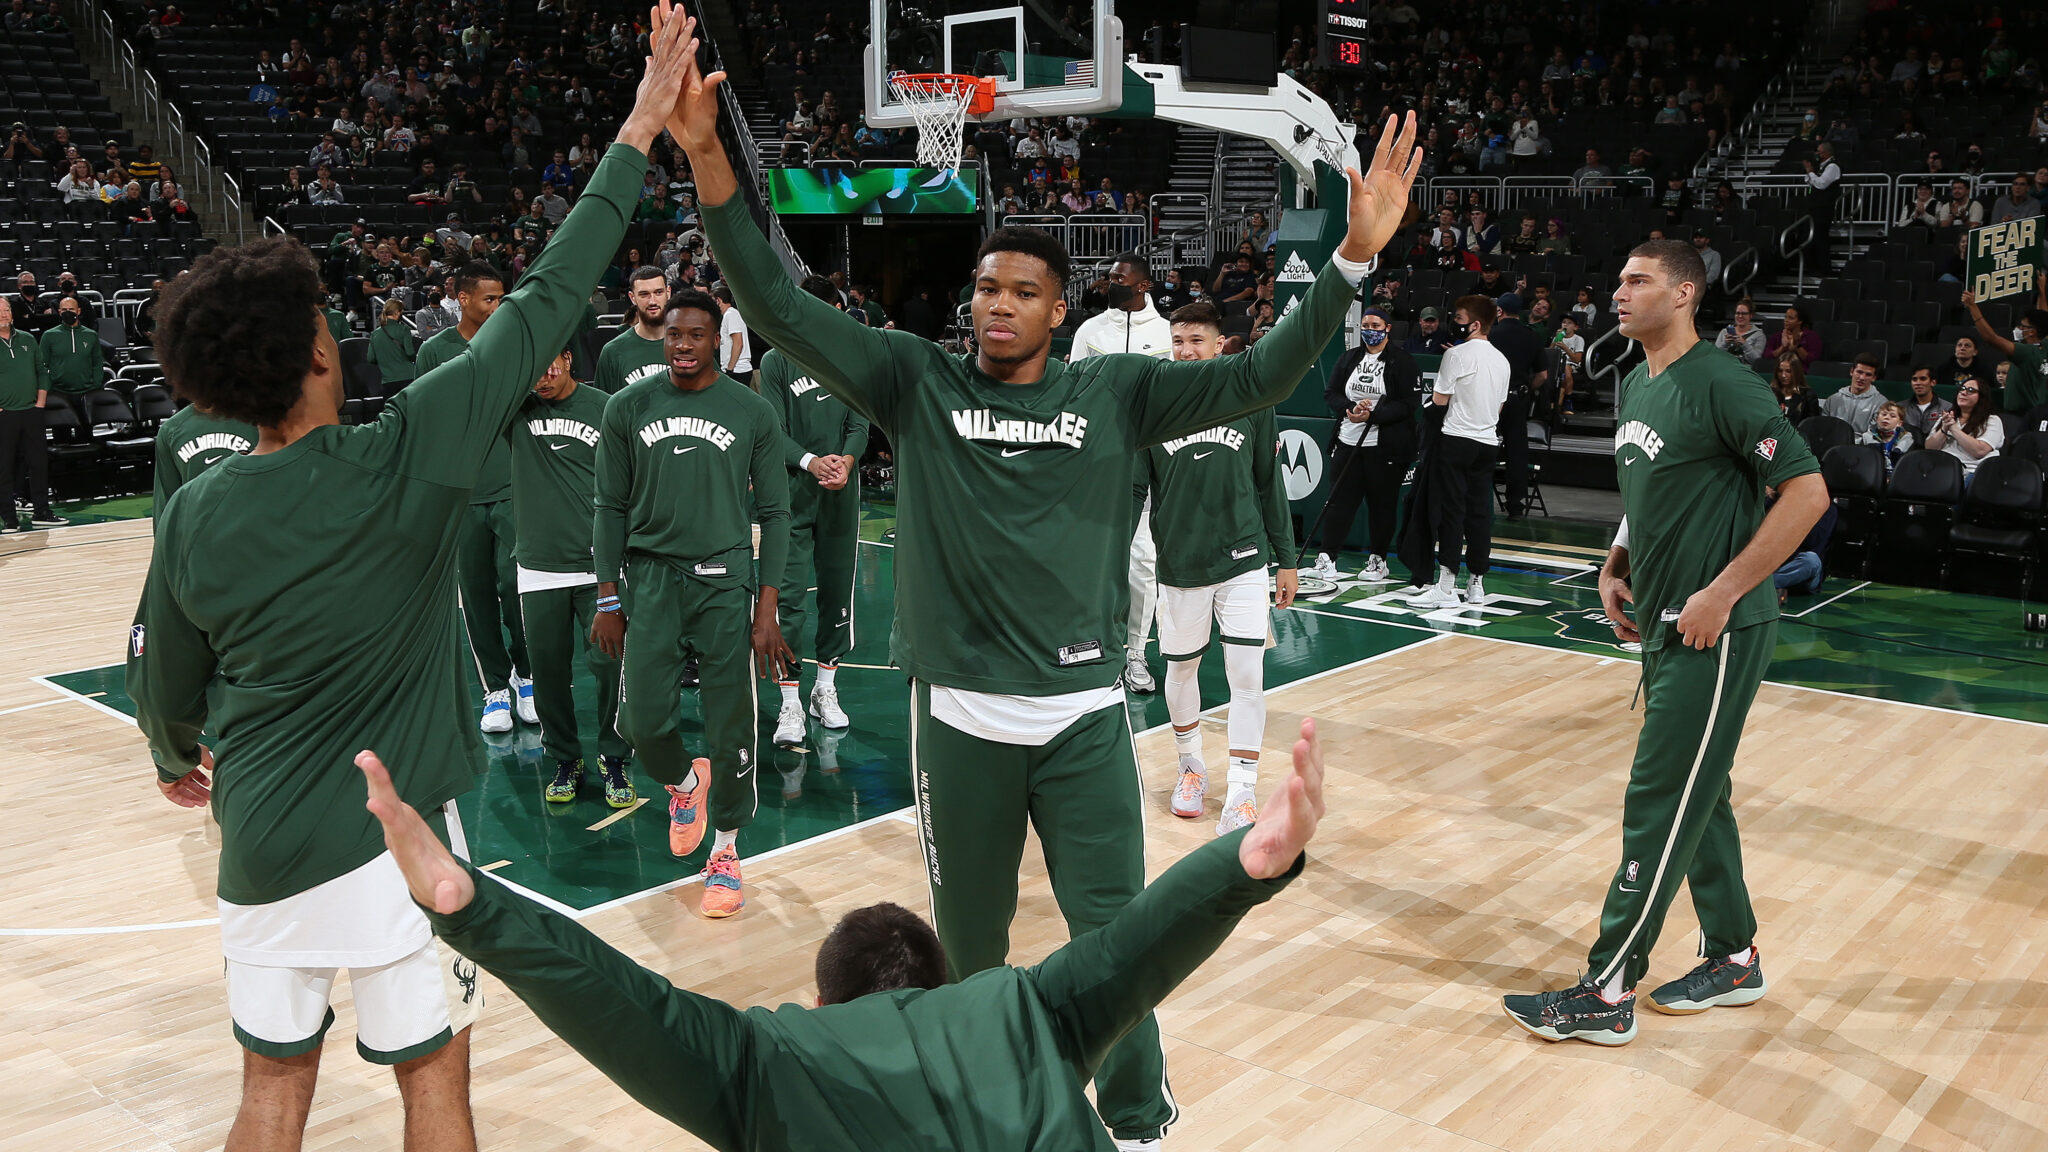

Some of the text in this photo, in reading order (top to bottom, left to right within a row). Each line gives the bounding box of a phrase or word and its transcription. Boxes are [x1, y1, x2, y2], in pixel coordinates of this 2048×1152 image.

[1339, 15, 1367, 29] TISSOT
[1340, 42, 1361, 64] 1:30
[1977, 218, 2036, 258] FEAR
[1283, 260, 1311, 274] Coors
[1993, 250, 2019, 270] THE
[1974, 263, 2034, 304] DEER
[625, 364, 671, 385] MILWAU
[1351, 383, 1382, 394] BASKETBALL
[527, 418, 601, 448] MILWAUKEE
[639, 416, 736, 452] MILWAUKEE
[952, 408, 1088, 449] MILWAUKEE
[1161, 425, 1246, 457] MILWAUKEE
[177, 432, 252, 463] MILWAUKEE
[920, 769, 942, 887] MILWAUKEE BUCKS
